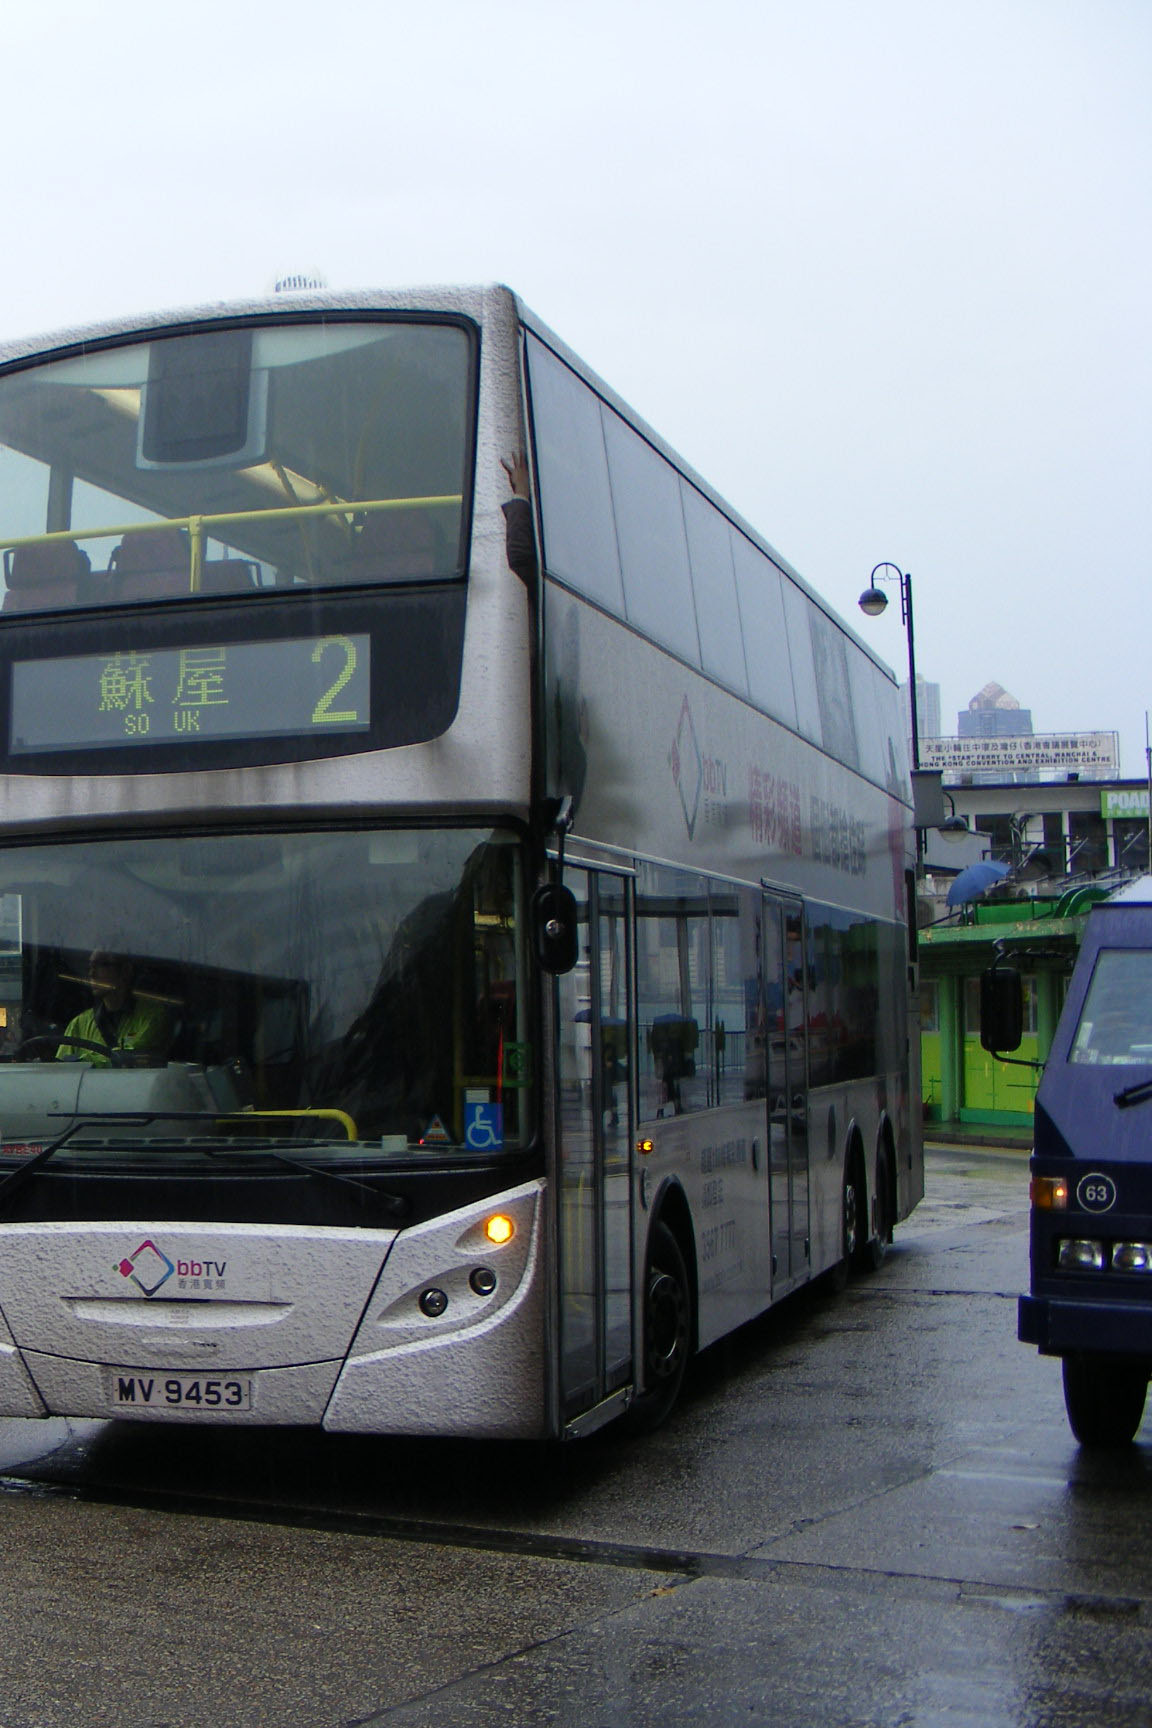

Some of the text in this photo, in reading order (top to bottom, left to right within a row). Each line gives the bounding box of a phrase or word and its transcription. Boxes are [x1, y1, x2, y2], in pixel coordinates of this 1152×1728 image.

[98, 647, 230, 711] 蘇屋
[311, 634, 357, 723] 2
[125, 710, 200, 735] SO UK
[966, 759, 1016, 767] CONVENTION
[1035, 757, 1079, 765] EXHIBITION
[976, 753, 1001, 761] FERRY
[1086, 1185, 1107, 1201] 63
[177, 1259, 227, 1277] bbTV
[118, 1378, 243, 1406] MV 9453
